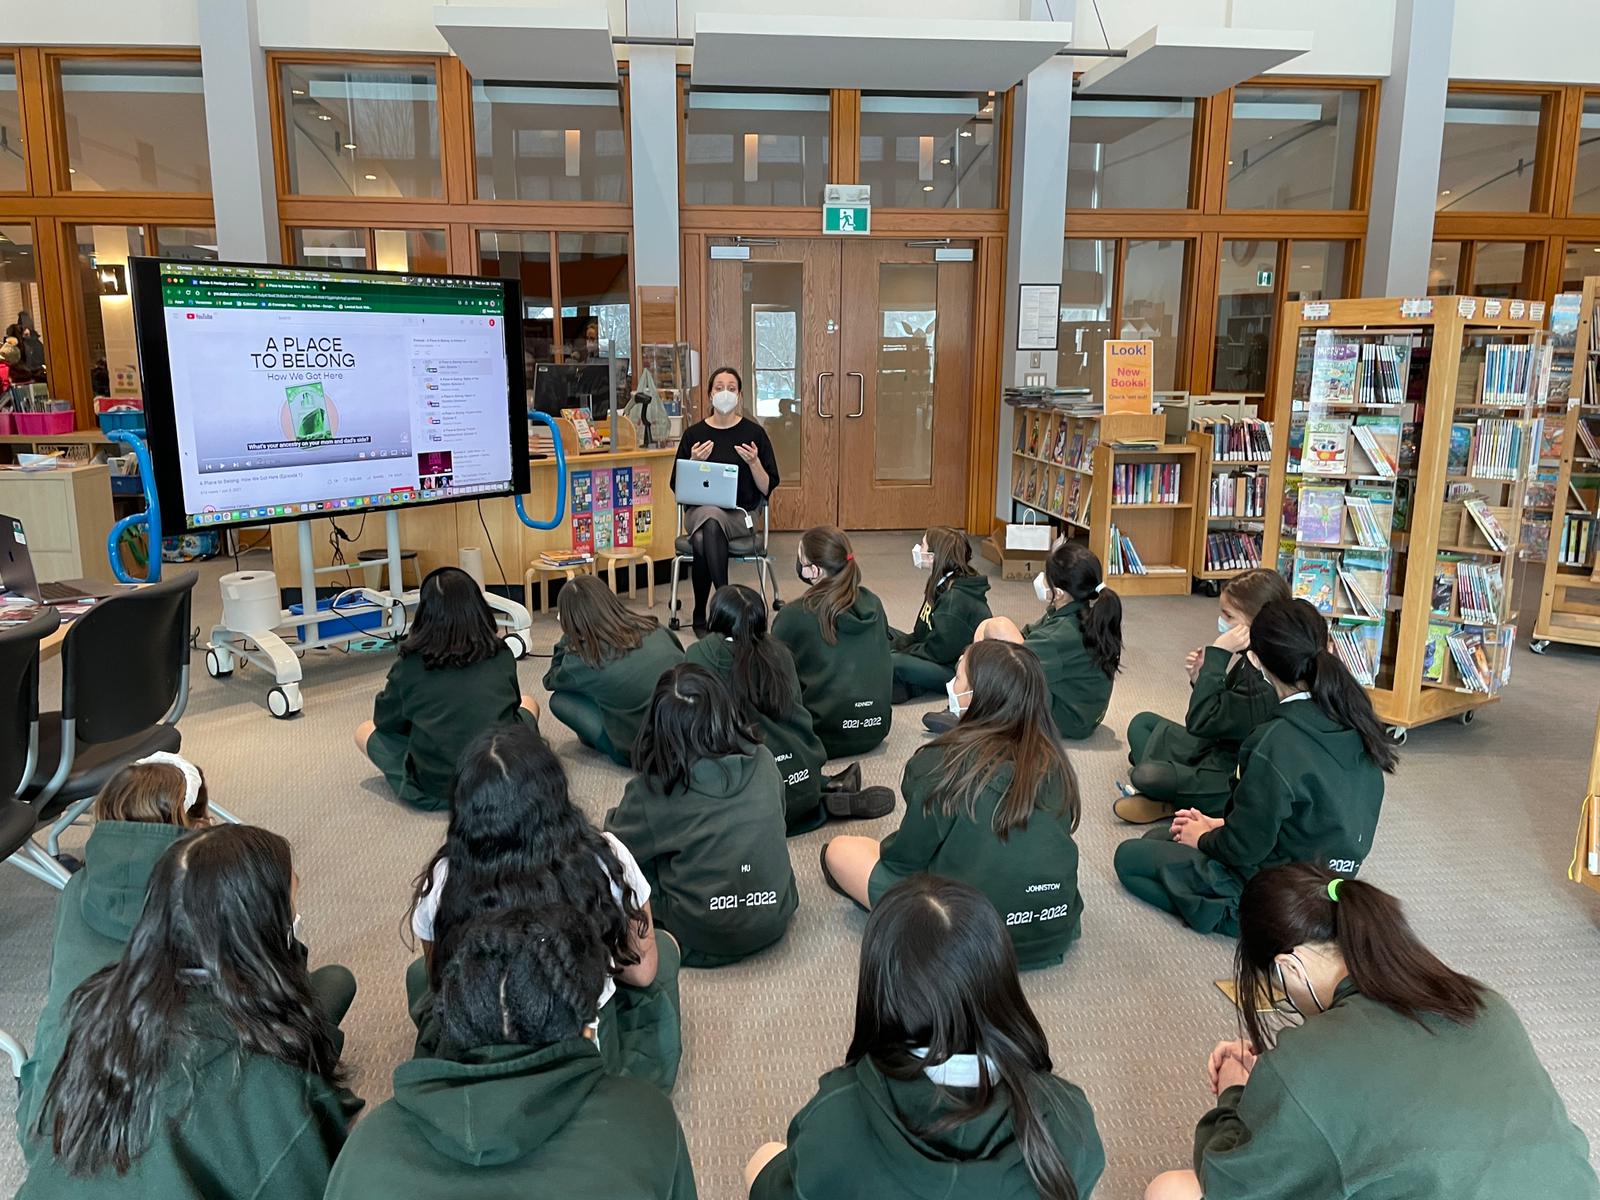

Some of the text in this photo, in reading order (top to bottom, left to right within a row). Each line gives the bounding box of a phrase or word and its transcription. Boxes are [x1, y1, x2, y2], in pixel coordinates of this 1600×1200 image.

[266, 337, 343, 352] A PLACE
[1111, 344, 1147, 356] Look!
[250, 353, 356, 368] TO BELONG
[267, 373, 287, 381] How
[305, 372, 322, 380] Got
[323, 372, 343, 380] Here
[1117, 367, 1141, 377] New
[1111, 378, 1147, 387] Books!
[1025, 562, 1031, 571] 1
[842, 716, 882, 729] 2021-2022
[741, 864, 751, 873] HU
[1025, 882, 1061, 893] JOHNSTON
[709, 890, 777, 911] 2021-2022
[1006, 903, 1068, 926] 2021-2022
